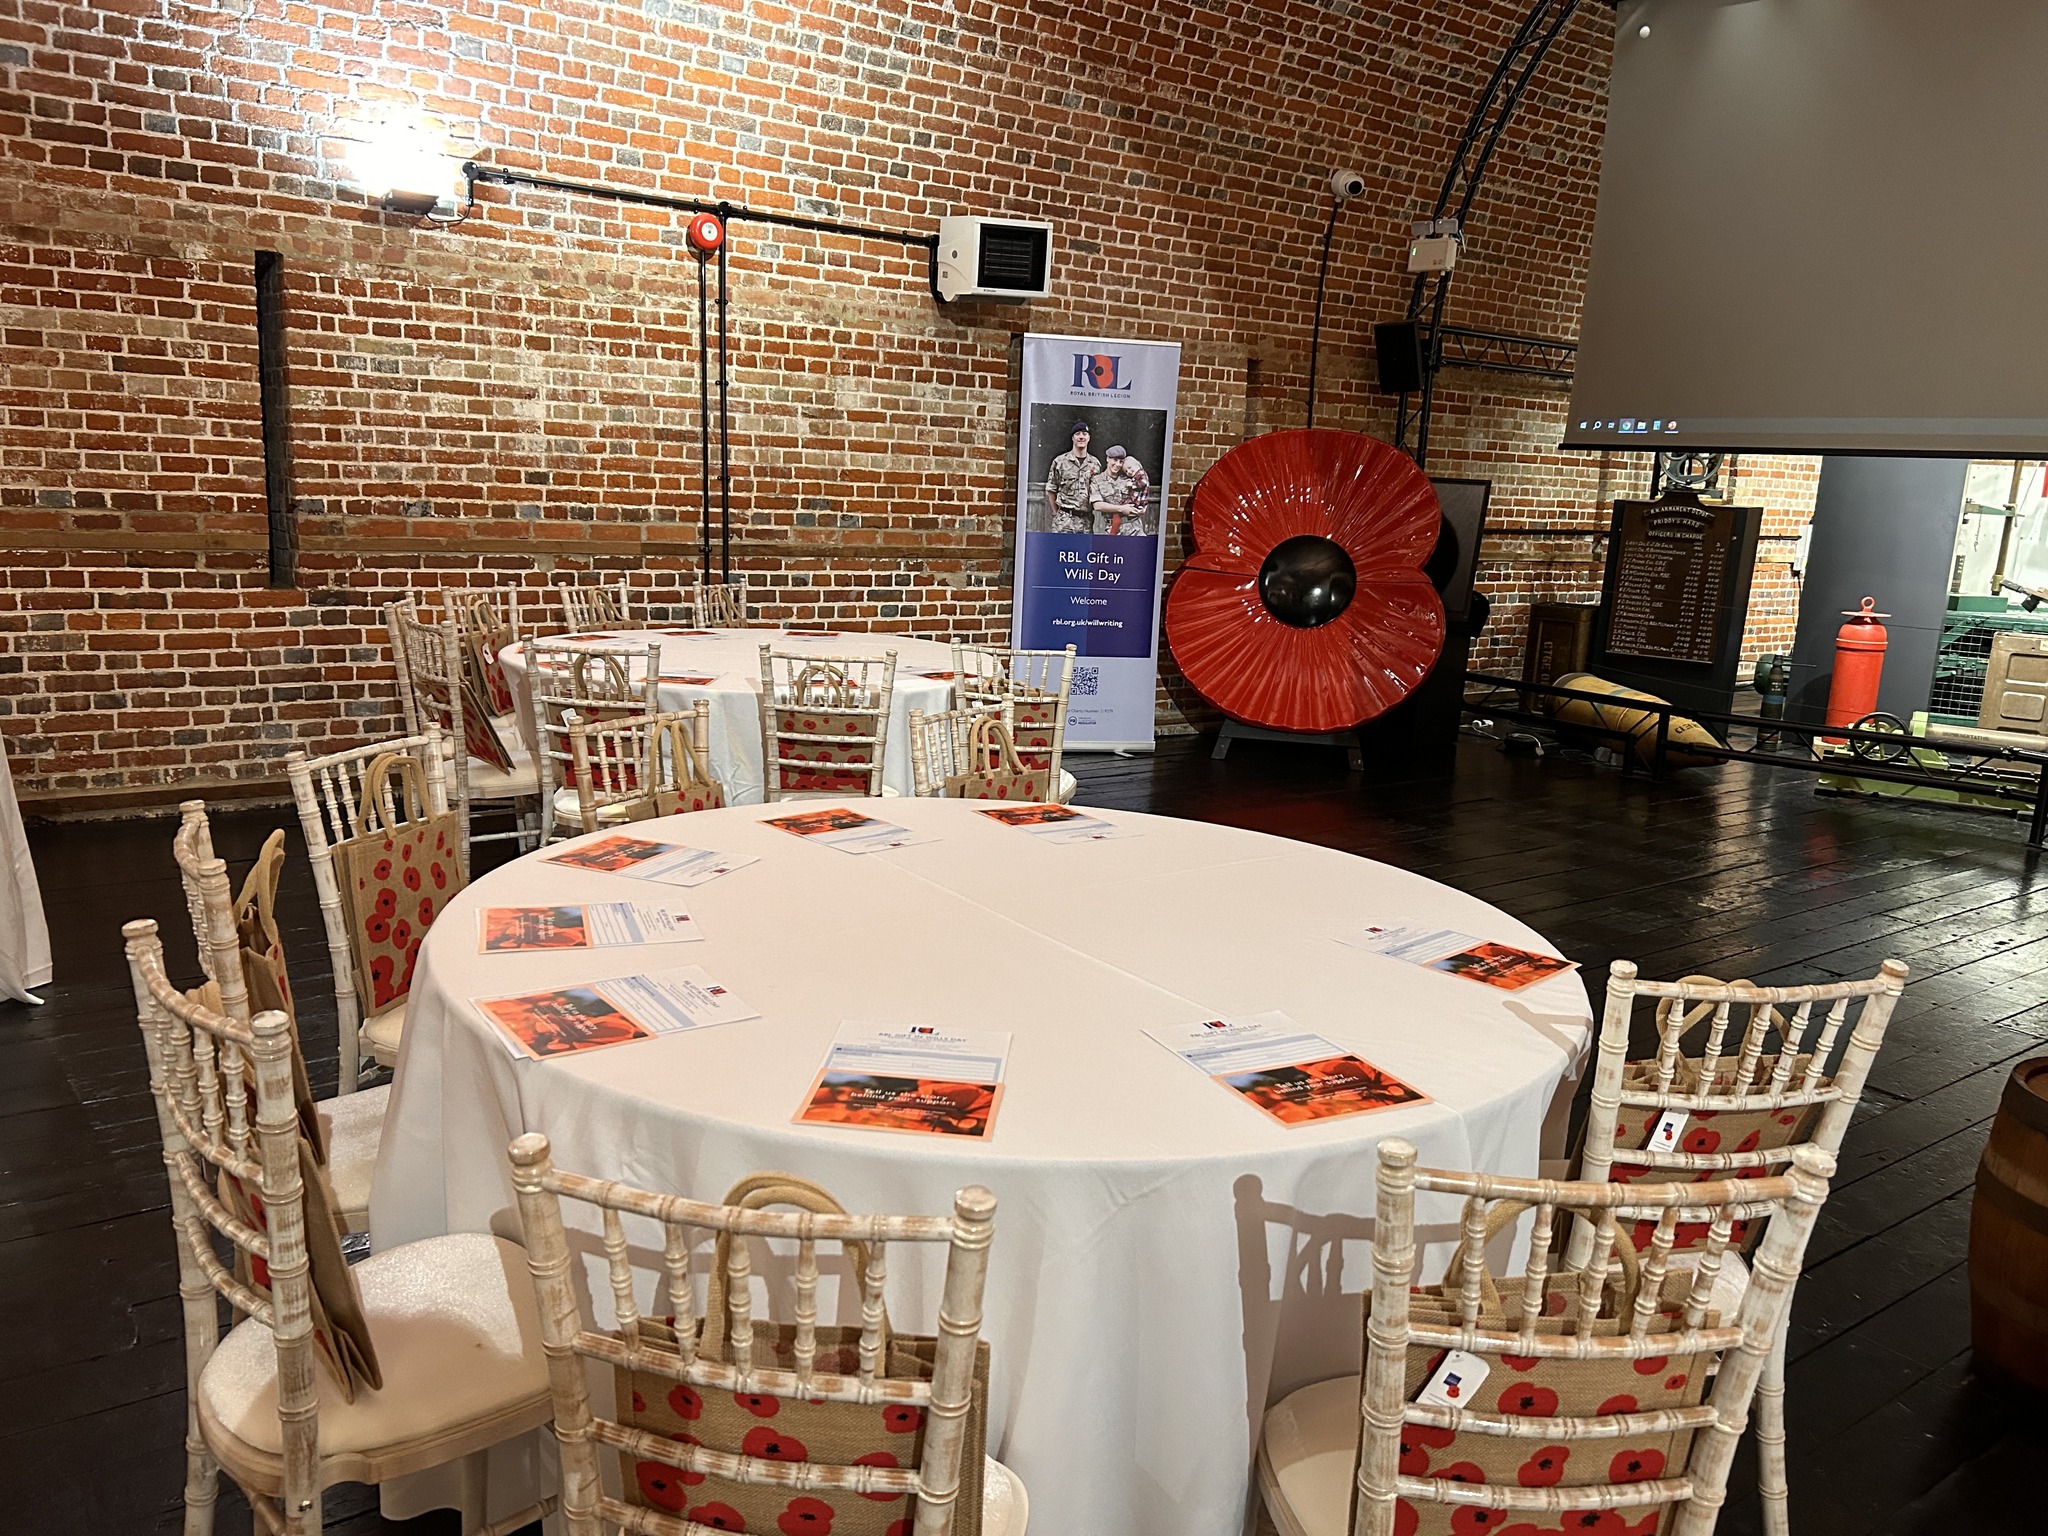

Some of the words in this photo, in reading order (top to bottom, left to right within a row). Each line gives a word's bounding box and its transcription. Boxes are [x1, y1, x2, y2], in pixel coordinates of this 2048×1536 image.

[1682, 519, 1700, 528] HARD
[1059, 552, 1082, 563] RBL
[1086, 552, 1110, 564] Gift
[1114, 554, 1124, 564] in
[1065, 568, 1093, 580] Wills
[1098, 570, 1121, 584] Day
[1070, 596, 1108, 606] Welcome
[1052, 619, 1124, 628] rbl.org.uk/willwriting
[850, 1091, 886, 1100] behind
[915, 1097, 957, 1107] support
